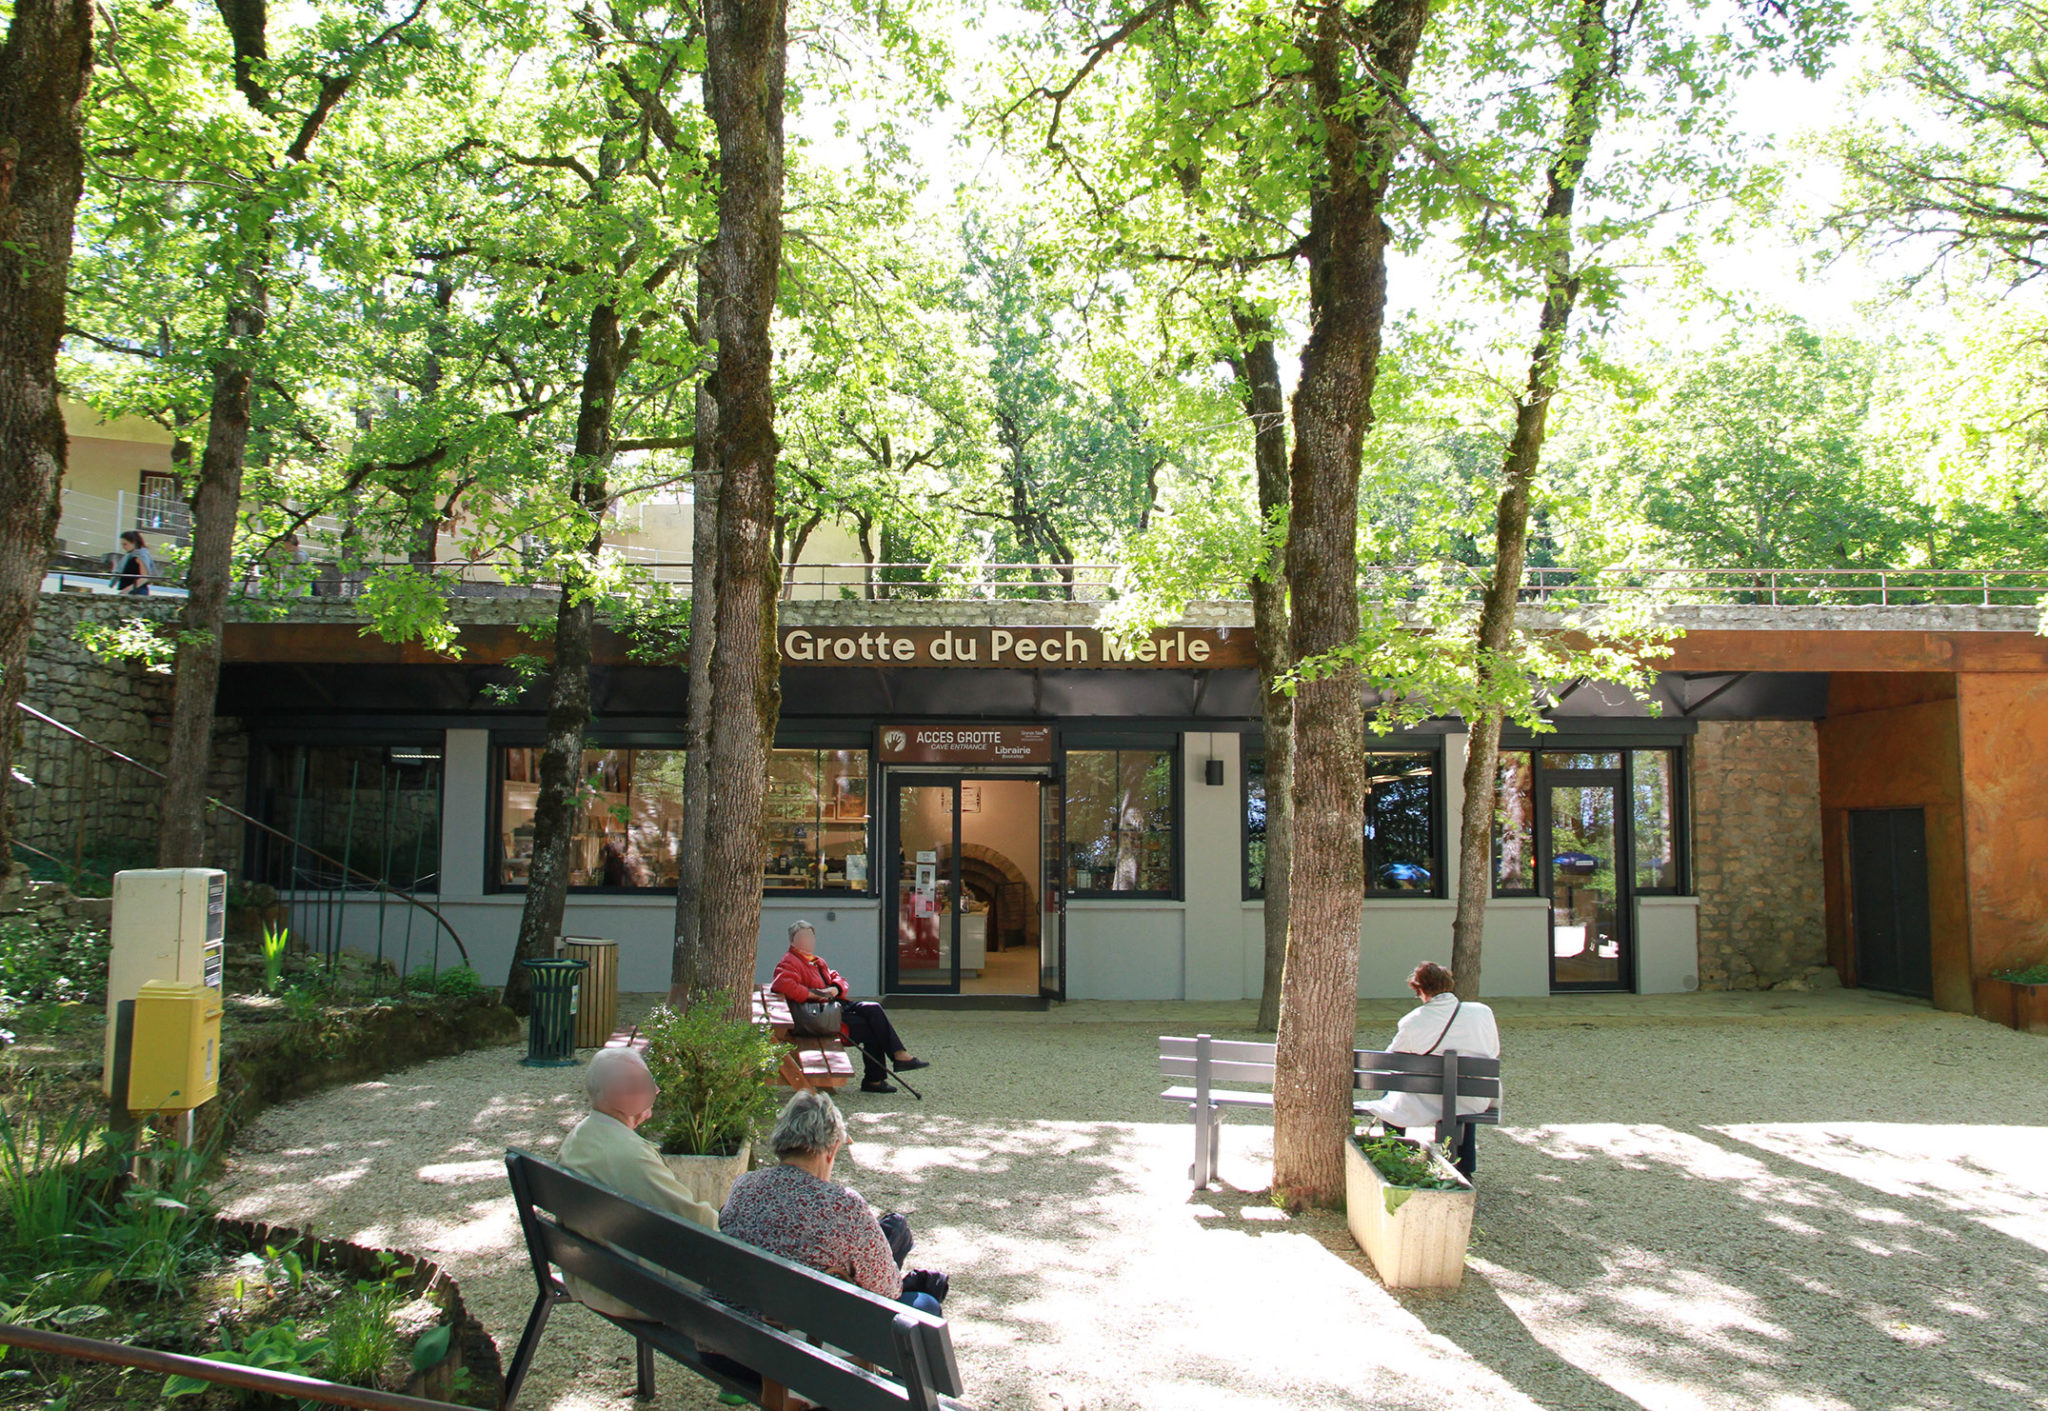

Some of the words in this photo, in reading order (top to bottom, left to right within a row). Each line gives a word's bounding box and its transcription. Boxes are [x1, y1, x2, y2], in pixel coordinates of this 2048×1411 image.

[784, 630, 915, 661] Grotte
[929, 630, 976, 661] du
[991, 630, 1088, 661] Pech
[1102, 631, 1210, 662] Merle
[916, 731, 954, 743] ACCES
[957, 731, 1001, 743] GROTTE
[995, 746, 1031, 755] Librairie
